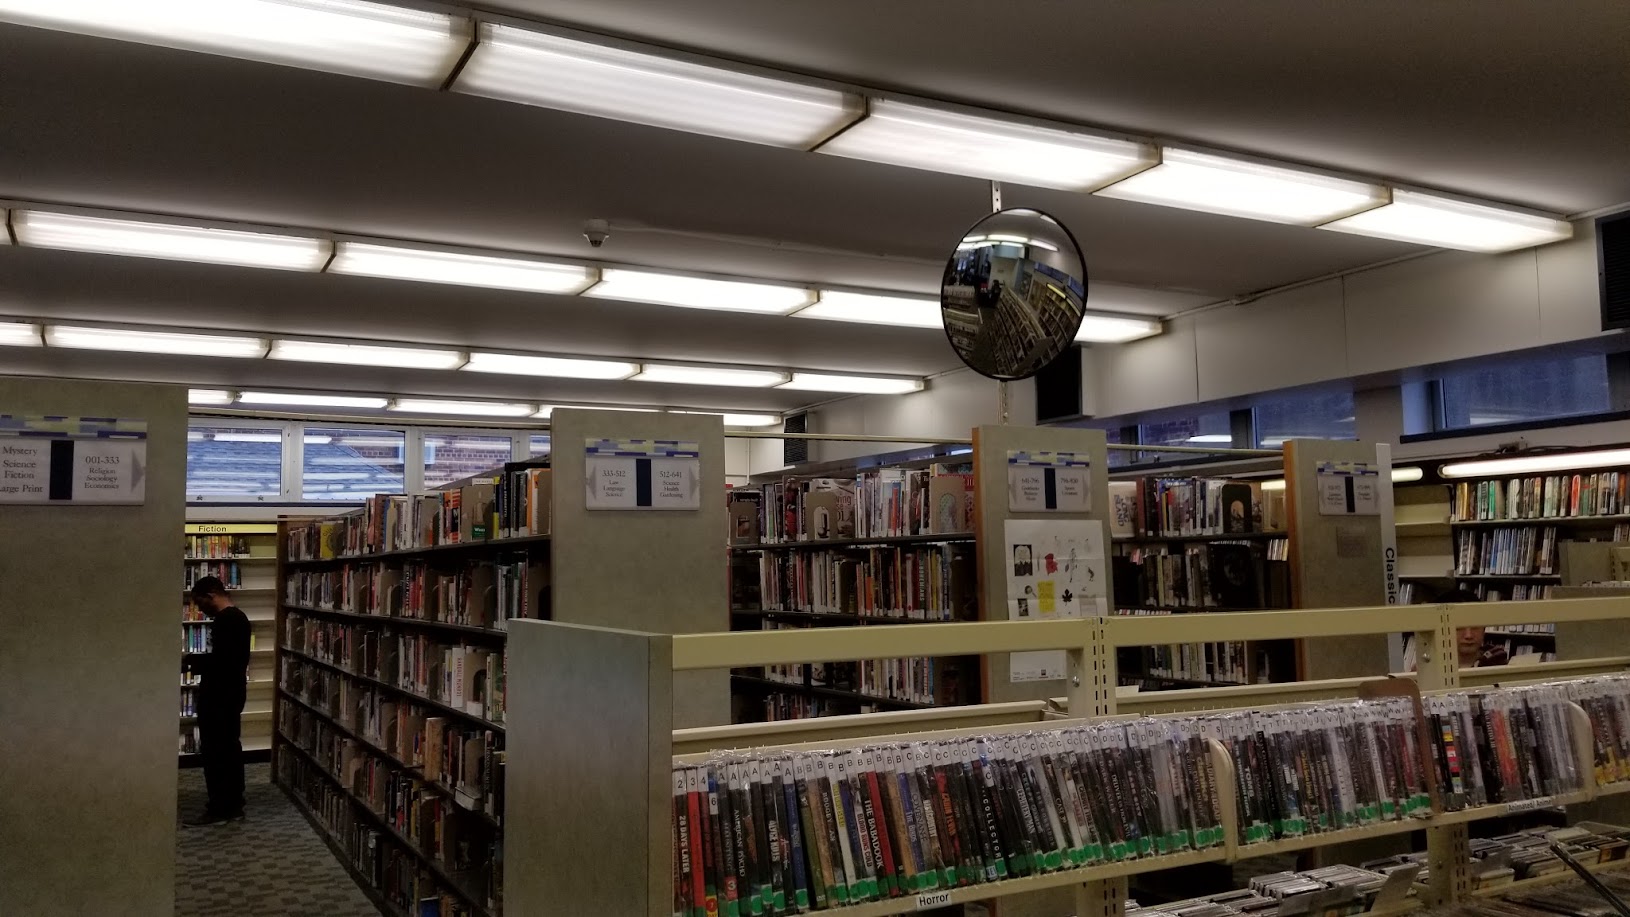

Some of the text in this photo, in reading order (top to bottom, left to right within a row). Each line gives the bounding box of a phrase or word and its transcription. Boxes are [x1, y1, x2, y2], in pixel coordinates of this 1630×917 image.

[3, 446, 37, 456] Mystery
[3, 460, 36, 468] Science
[86, 456, 120, 464] 001-333
[4, 470, 34, 478] Fiction
[602, 470, 626, 478] 333-512
[86, 475, 118, 483] Sociology
[22, 484, 43, 492] Print
[1386, 548, 1396, 604] Classic
[774, 763, 780, 771] A
[817, 760, 823, 769] B
[838, 764, 844, 772] B
[743, 770, 749, 778] A
[785, 768, 791, 776] A
[731, 772, 737, 781] A
[678, 780, 683, 788] 2
[691, 777, 696, 785] 3
[712, 797, 716, 805] 6
[679, 815, 686, 825] 28
[982, 798, 1002, 858] COLLECTOR
[864, 799, 884, 868] THE BABADOOK
[733, 809, 746, 876] AMERICAN PSYCHO
[856, 813, 873, 867] BLOOD RUNS COLD
[681, 848, 689, 872] LATER
[920, 894, 948, 906] Horror
